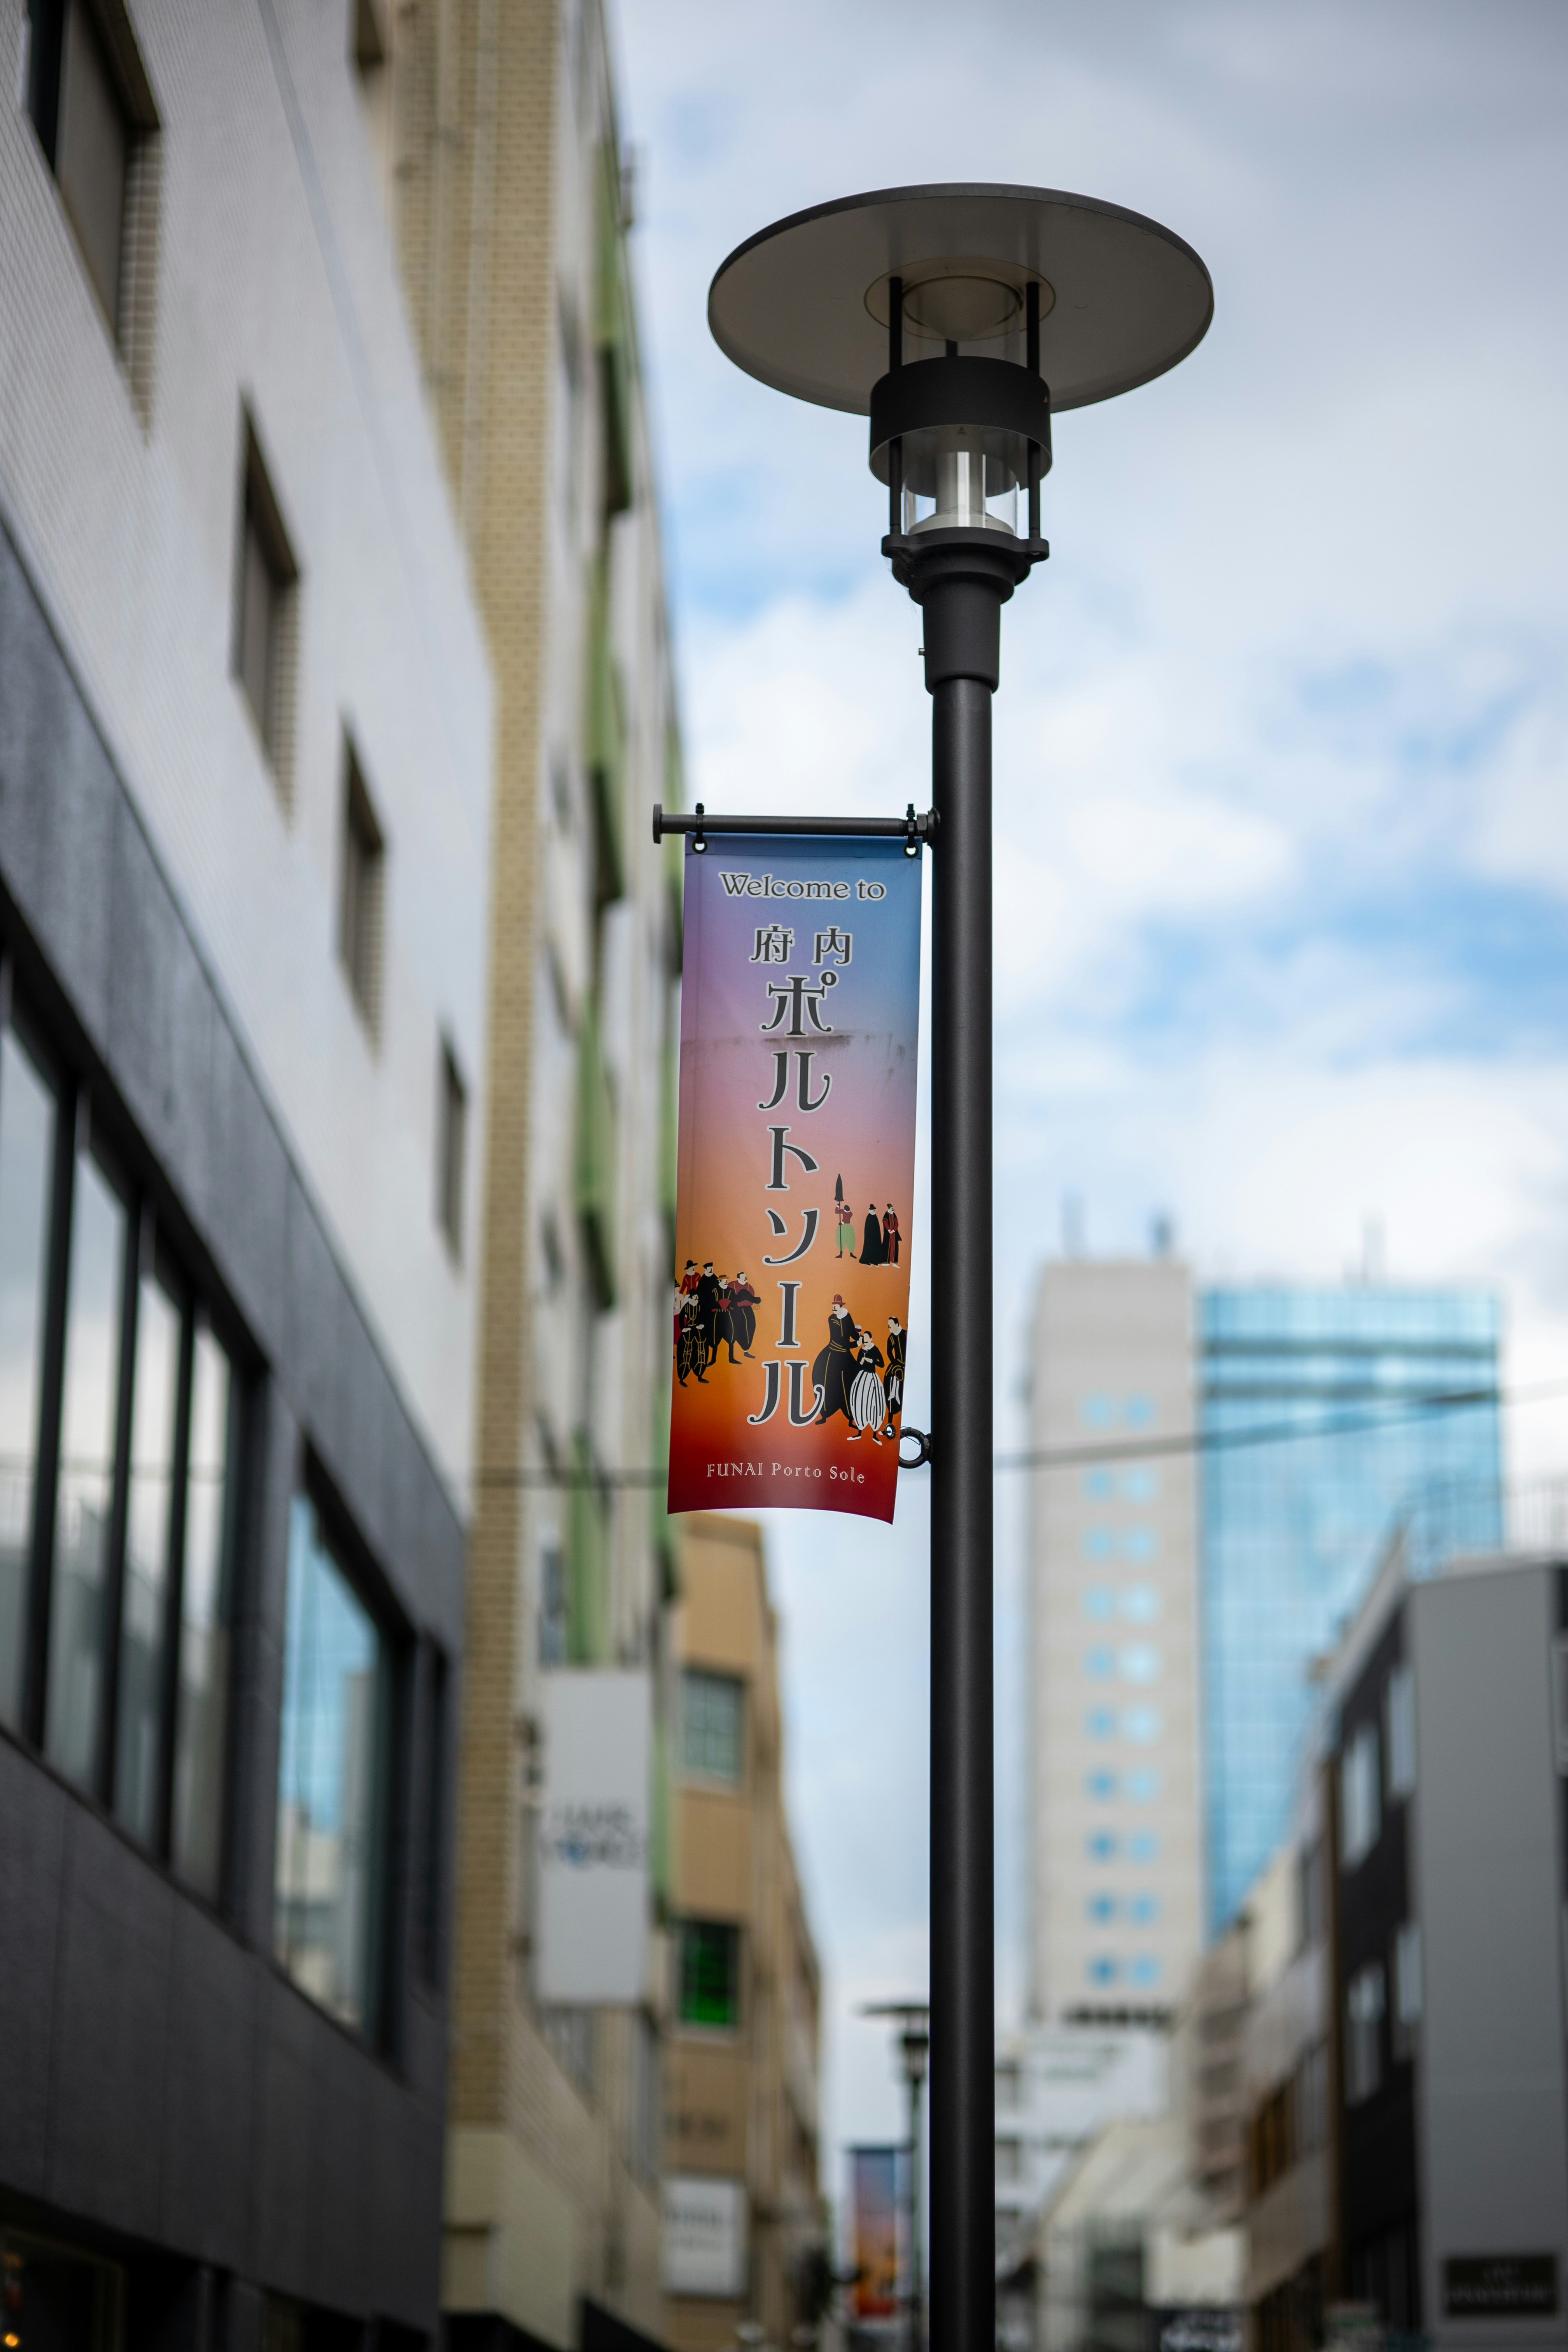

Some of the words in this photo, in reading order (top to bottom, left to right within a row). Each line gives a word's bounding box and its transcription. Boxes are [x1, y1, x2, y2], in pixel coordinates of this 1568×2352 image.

[719, 872, 850, 899] Welcome
[856, 880, 886, 900] to
[750, 924, 852, 966] 府内
[707, 1462, 763, 1477] FUNAI
[772, 1462, 822, 1478] Porto
[830, 1466, 865, 1484] Sole
